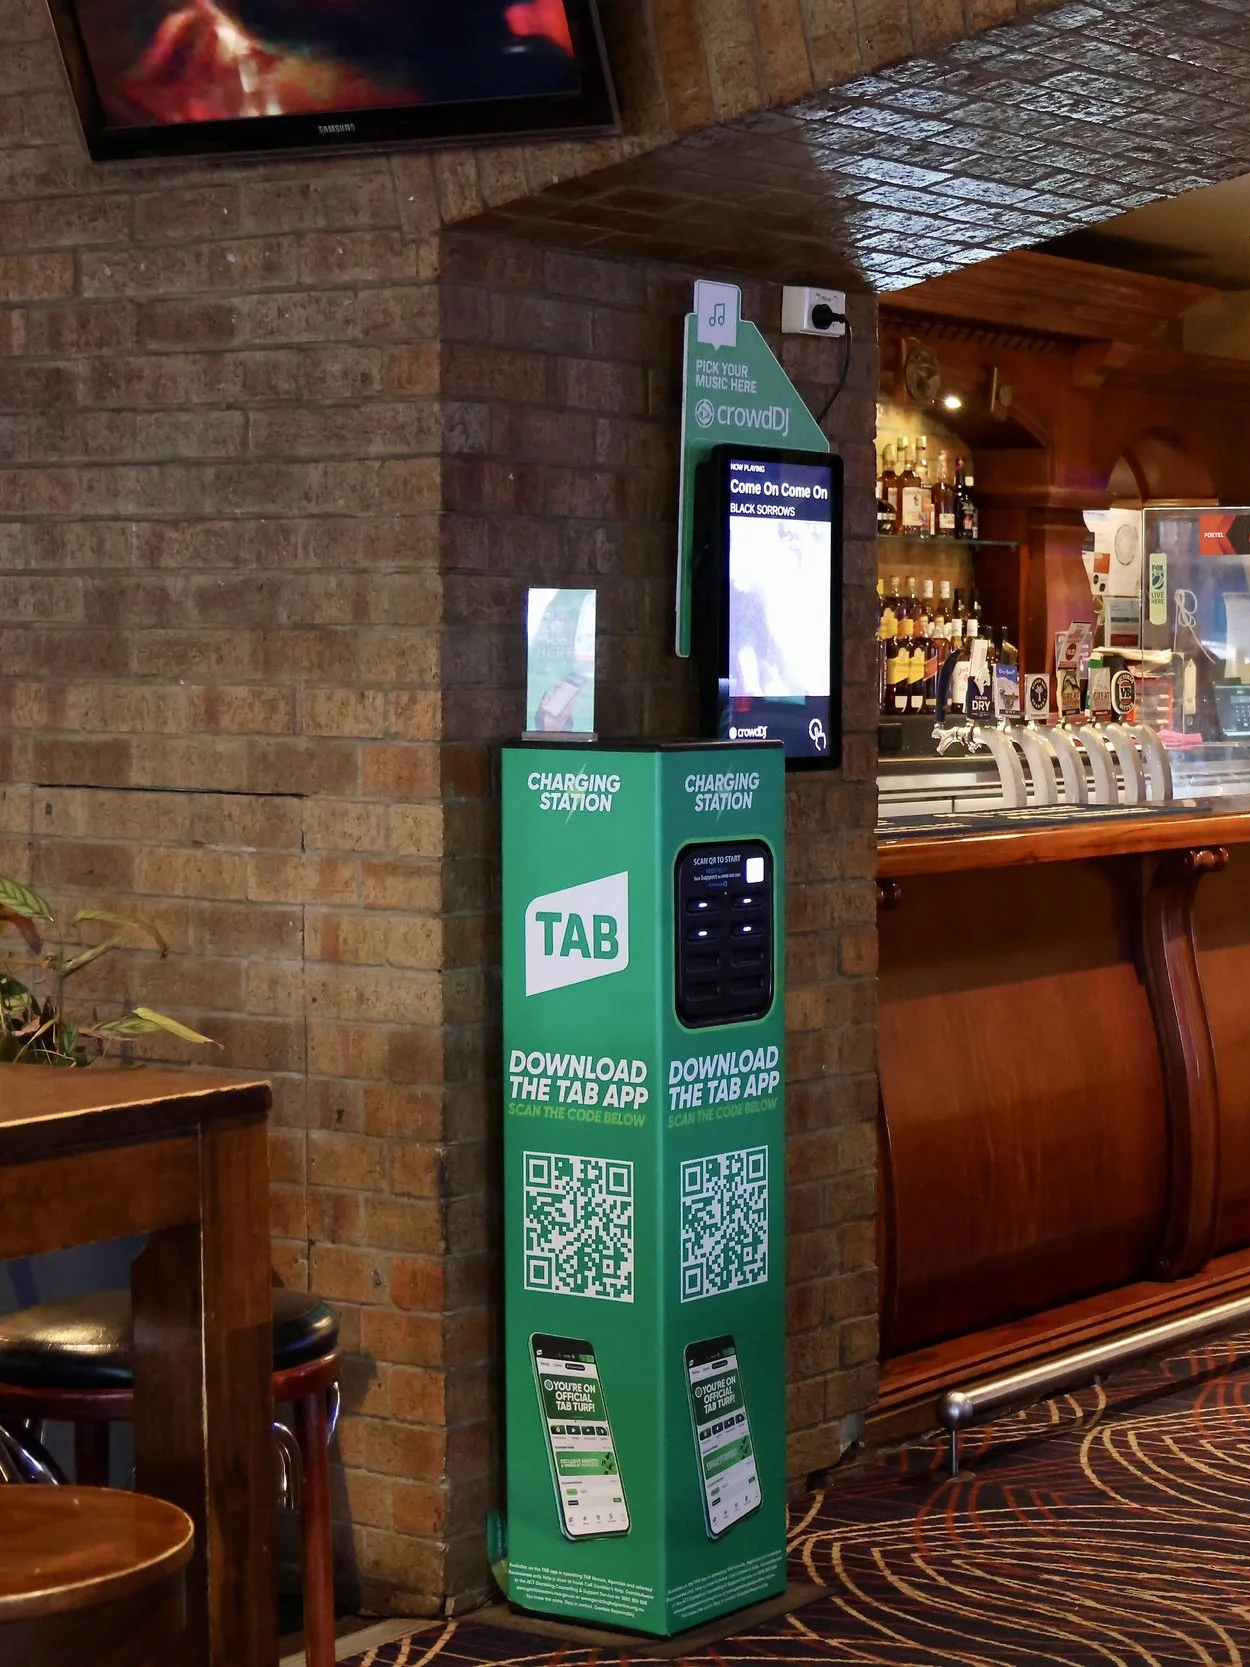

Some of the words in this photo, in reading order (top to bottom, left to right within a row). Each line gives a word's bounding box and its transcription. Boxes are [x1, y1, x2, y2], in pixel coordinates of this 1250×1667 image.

[696, 359, 719, 374] PICK
[722, 362, 748, 378] YOUR
[696, 374, 728, 390] MUSIC
[730, 378, 757, 394] HERE
[717, 404, 789, 437] crowdDJ
[730, 463, 743, 471] NOW
[743, 464, 766, 473] PLAYING
[730, 479, 761, 495] Come
[763, 481, 779, 496] On
[781, 482, 811, 498] Come
[813, 485, 828, 500] On
[730, 502, 756, 514] BLACK
[756, 504, 796, 517] SORROWS
[1152, 564, 1164, 572] FOX
[1092, 691, 1110, 700] GREAT
[1120, 687, 1132, 698] VB
[972, 700, 991, 712] DRY
[737, 726, 768, 740] crowdDJ
[528, 772, 621, 793] CHARGING
[684, 772, 760, 792] CHARGING
[539, 792, 612, 812] STATION
[694, 792, 753, 812] STATION
[693, 857, 708, 866] SCAN
[709, 856, 716, 865] QR
[717, 856, 725, 864] TO
[725, 854, 741, 863] START
[535, 911, 619, 960] TAB
[508, 1049, 648, 1084] DOWNLOAD
[668, 1045, 780, 1085] DOWNLOAD
[509, 1075, 552, 1102] THE
[556, 1079, 599, 1106] TAB
[602, 1084, 649, 1110] APP
[668, 1084, 704, 1111] THE
[706, 1078, 741, 1104] TAB
[743, 1070, 780, 1098] APP
[508, 1102, 541, 1118] SCAN
[544, 1105, 566, 1120] THE
[567, 1108, 602, 1123] CODE
[604, 1111, 646, 1128] BELOW
[668, 1114, 694, 1129] SCAN
[697, 1109, 714, 1122] THE
[716, 1105, 744, 1121] CODE
[744, 1097, 778, 1115] BELOW
[553, 1381, 582, 1392] YOU'RE
[583, 1384, 596, 1394] ON
[702, 1379, 726, 1395] YOU'RE
[726, 1376, 736, 1386] ON
[704, 1386, 733, 1404] OFFICIAL
[556, 1390, 592, 1403] OFFICIAL
[704, 1402, 717, 1414] TAB
[718, 1394, 736, 1409] TURF!
[556, 1401, 572, 1411] TAB
[572, 1402, 596, 1412] TURF!
[608, 1578, 626, 1587] Agencies
